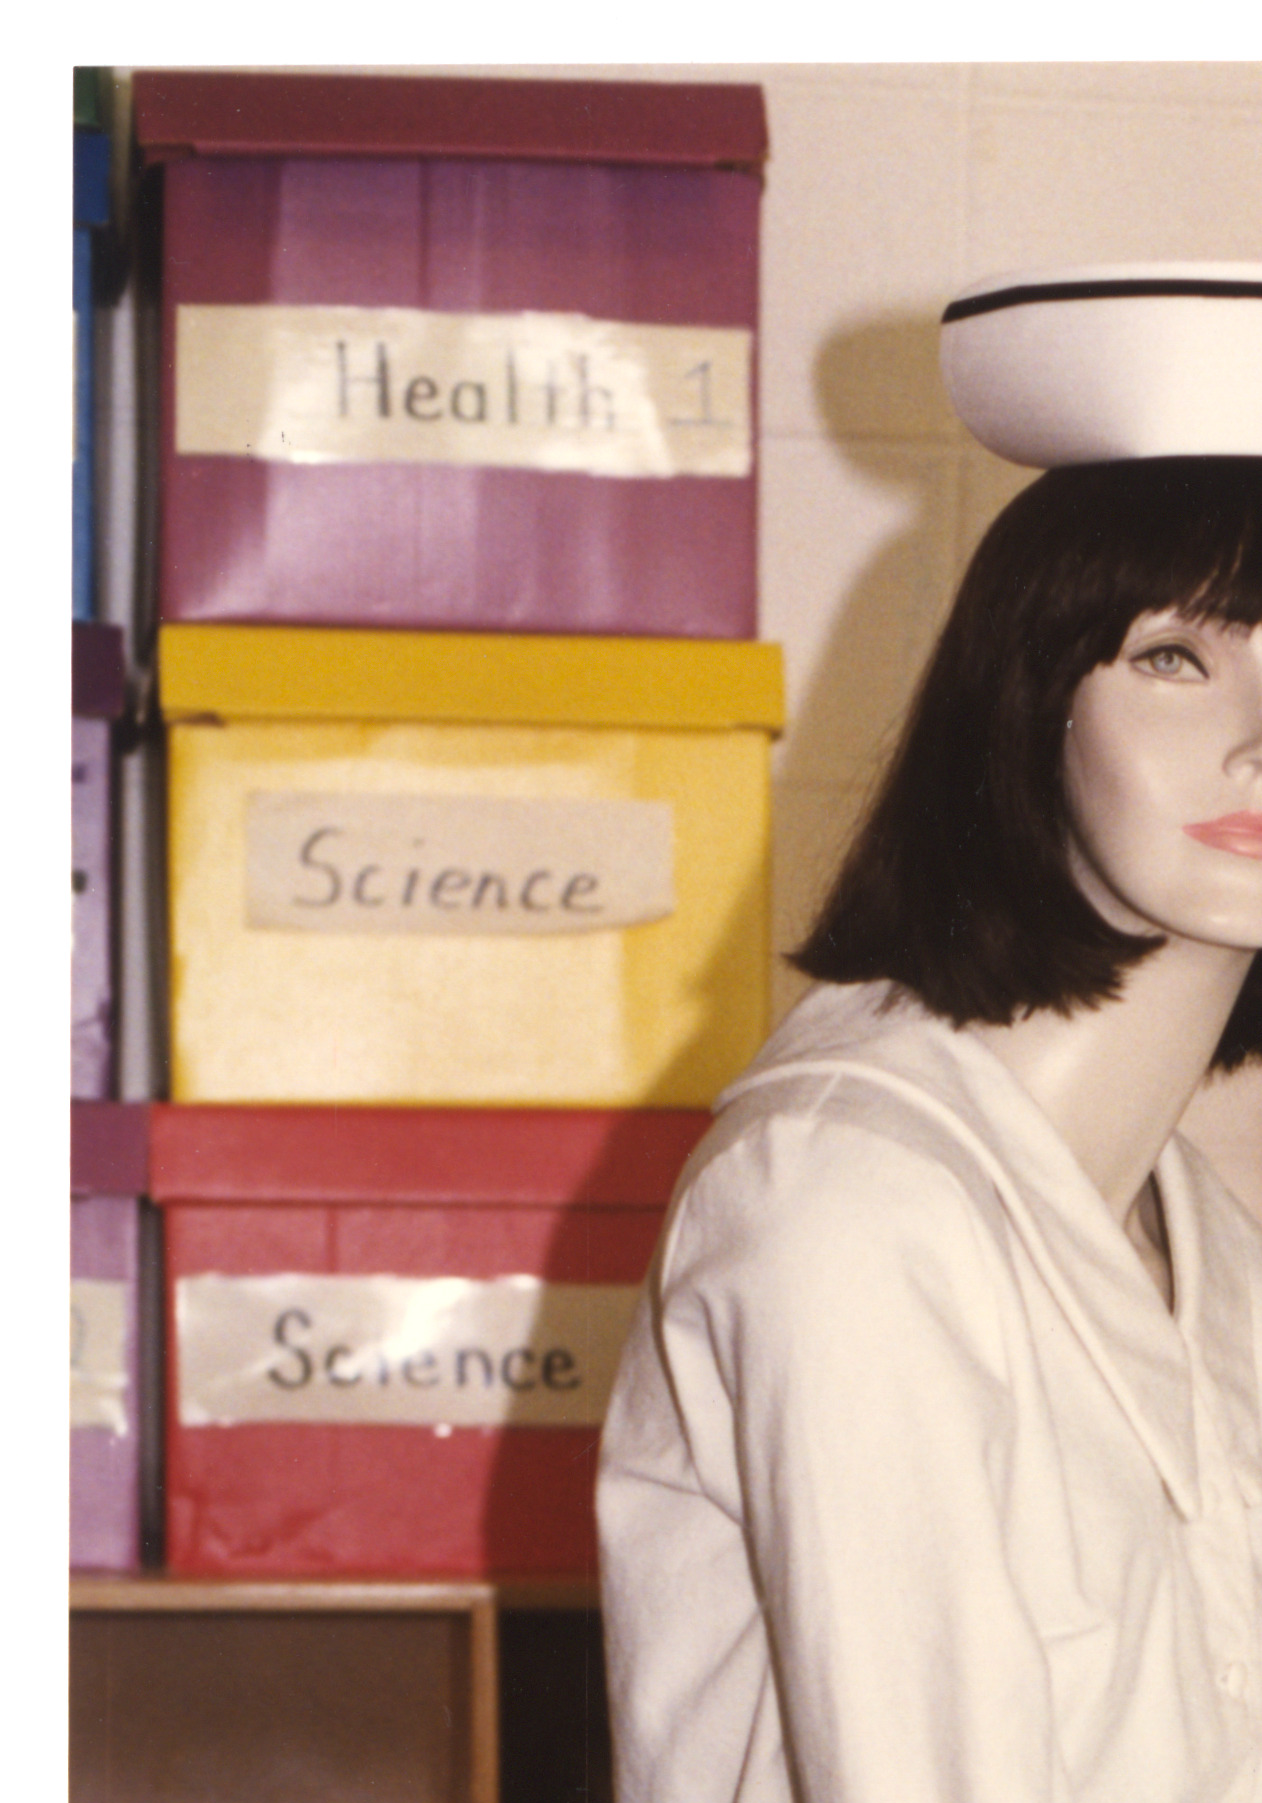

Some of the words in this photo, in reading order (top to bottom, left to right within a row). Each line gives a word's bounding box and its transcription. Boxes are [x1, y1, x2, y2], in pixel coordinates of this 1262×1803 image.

[332, 339, 618, 430] Health
[292, 826, 606, 916] Science
[265, 1309, 582, 1392] Science
